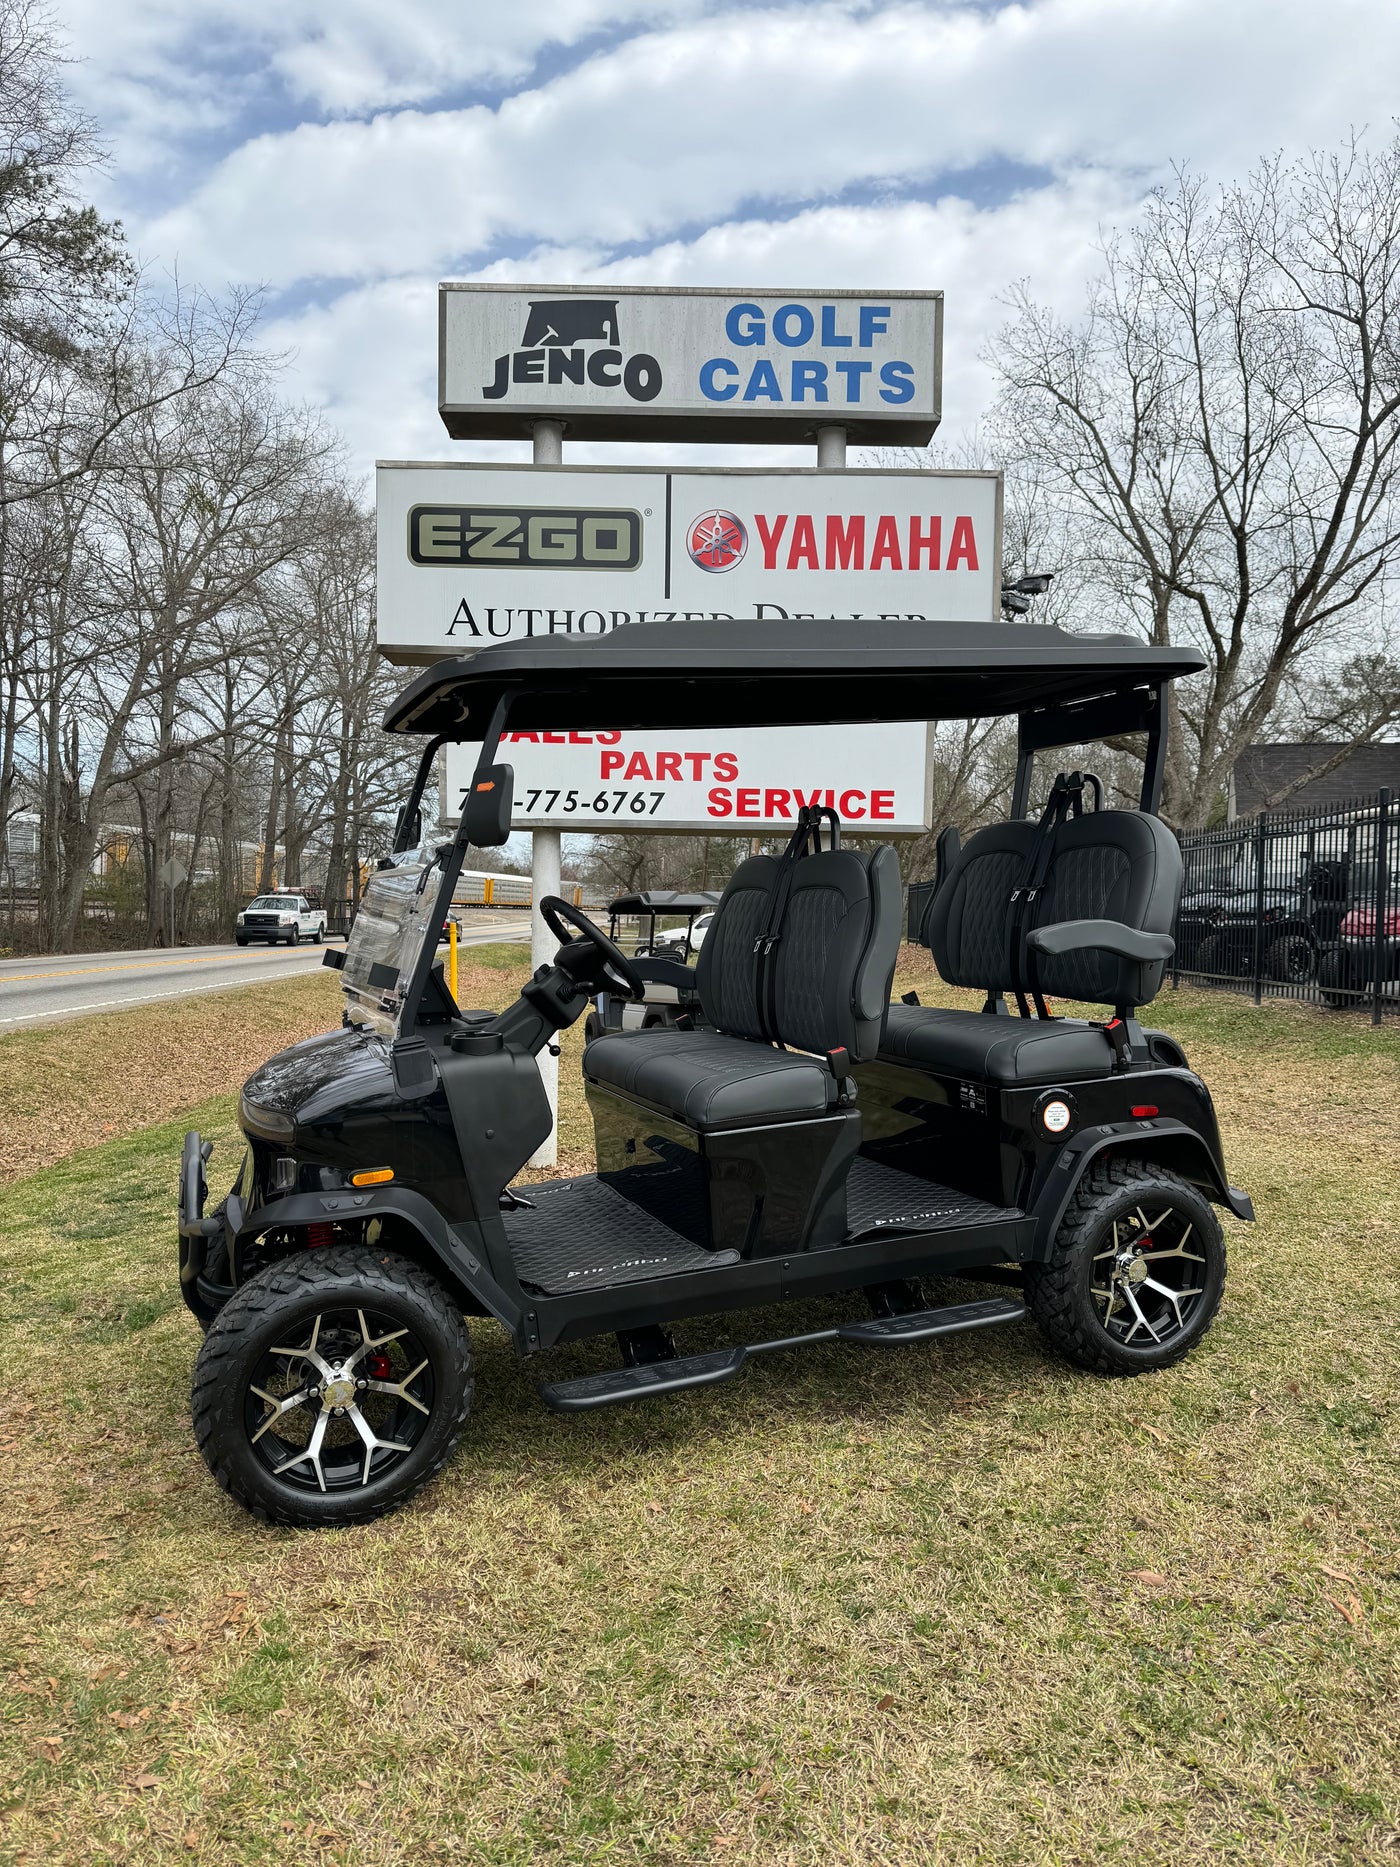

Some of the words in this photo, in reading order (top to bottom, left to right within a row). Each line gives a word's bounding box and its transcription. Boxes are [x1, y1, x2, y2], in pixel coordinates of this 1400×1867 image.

[725, 303, 891, 347] GOLF
[482, 348, 663, 402] JENCO
[699, 358, 916, 404] CARTS
[419, 514, 631, 562] EZGO
[754, 514, 980, 571] YAMAHA
[600, 750, 740, 783] PARTS
[458, 788, 666, 815] 7-775-6767
[706, 787, 896, 819] SERVICE
